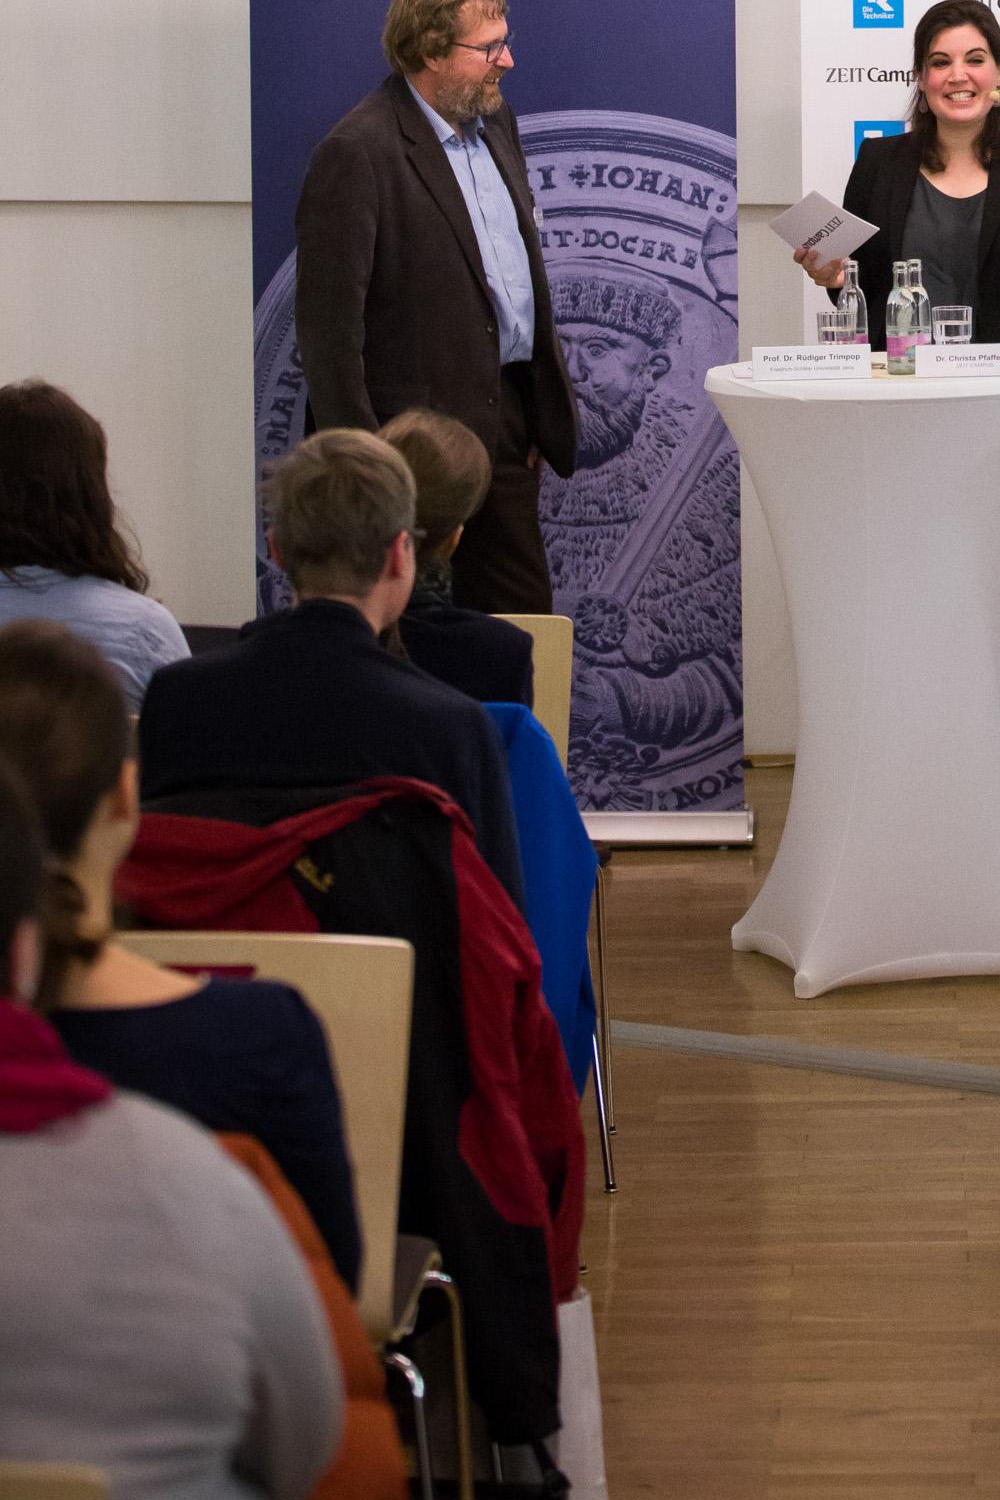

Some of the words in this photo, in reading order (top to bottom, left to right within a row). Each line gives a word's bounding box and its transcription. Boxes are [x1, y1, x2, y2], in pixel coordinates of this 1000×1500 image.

[868, 67, 915, 87] Camp
[796, 354, 826, 363] Rüdiger
[829, 353, 861, 362] Trimpop
[949, 354, 976, 362] Christa
